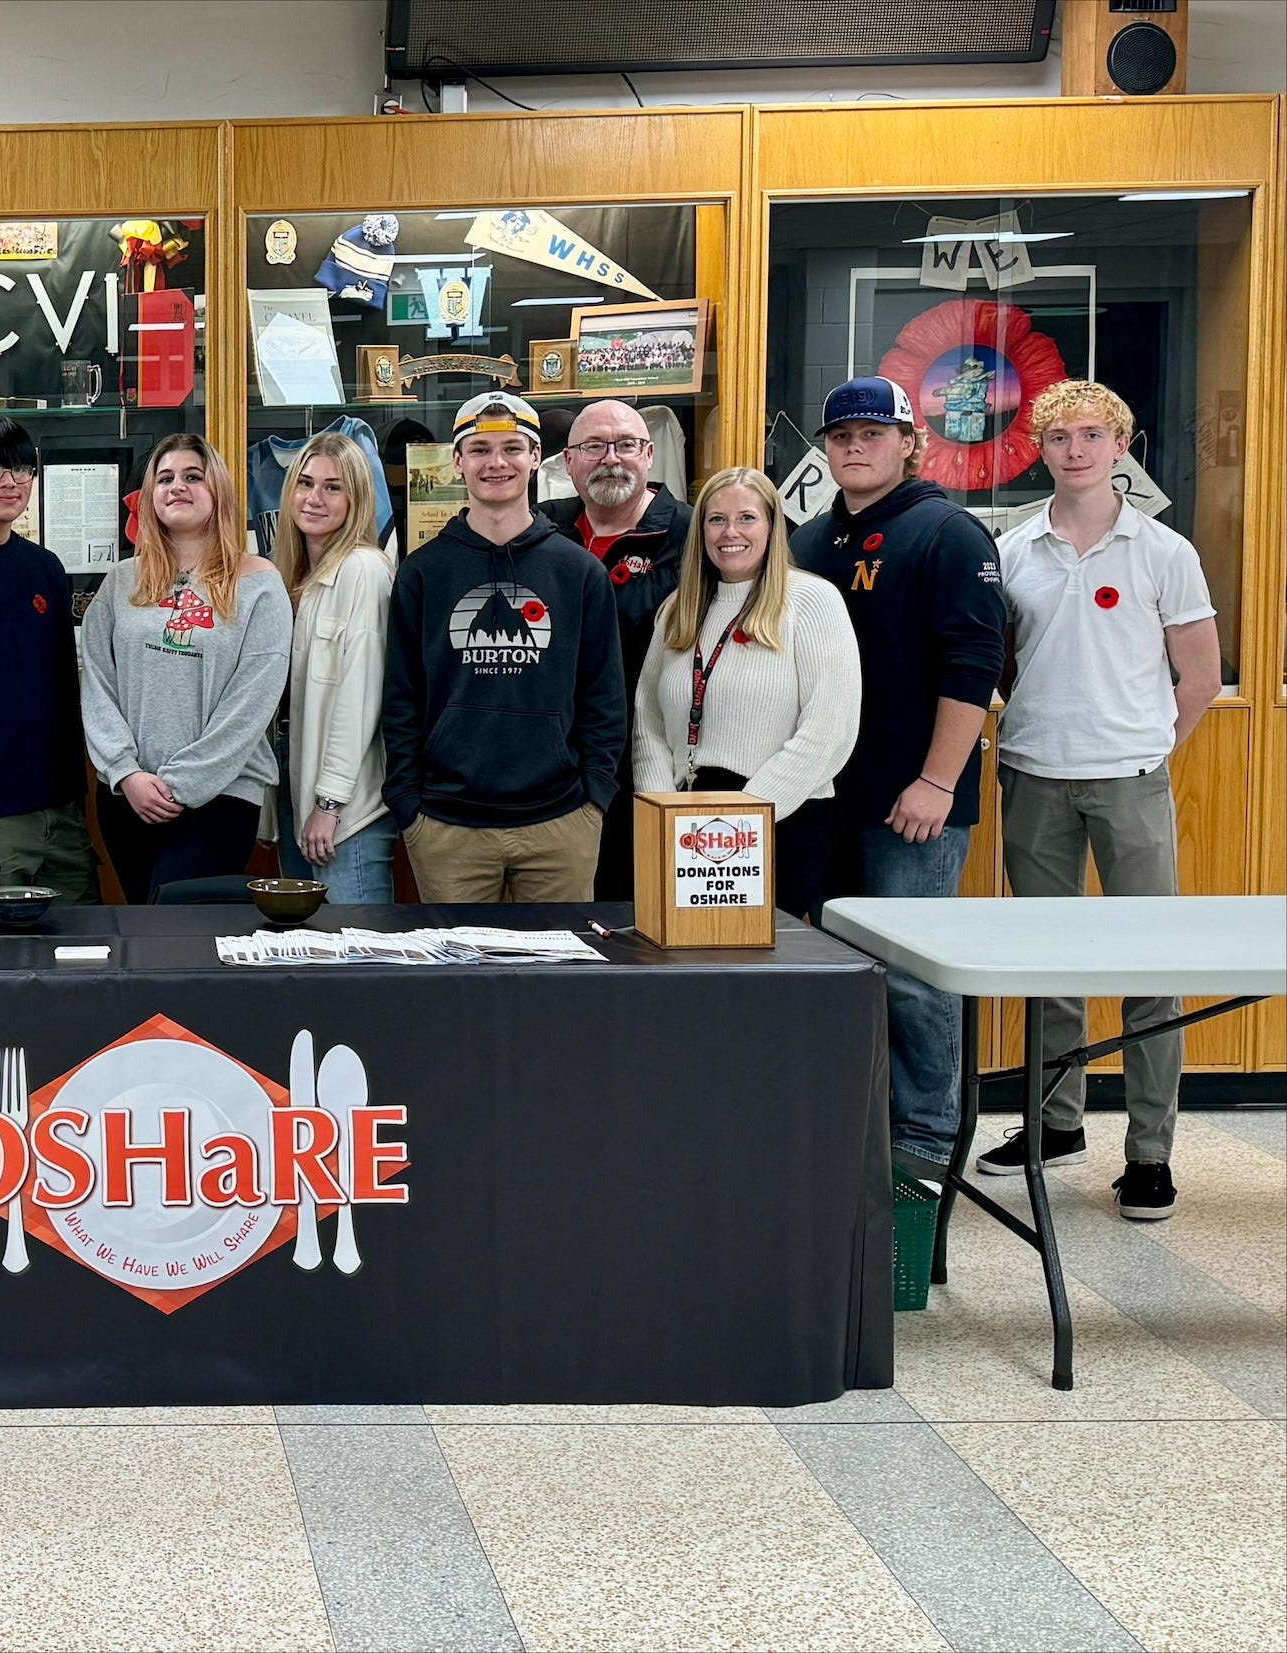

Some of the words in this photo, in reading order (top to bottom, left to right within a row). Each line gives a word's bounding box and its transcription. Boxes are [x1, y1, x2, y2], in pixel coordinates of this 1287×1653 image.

[548, 234, 625, 284] WHSS
[462, 649, 541, 665] BURTON
[474, 667, 498, 675] SINCE
[502, 667, 523, 675] 1977
[679, 830, 758, 850] OSHaRE
[677, 865, 760, 878] DONATIONS
[706, 880, 735, 891] FOR
[690, 893, 747, 905] OSHARE
